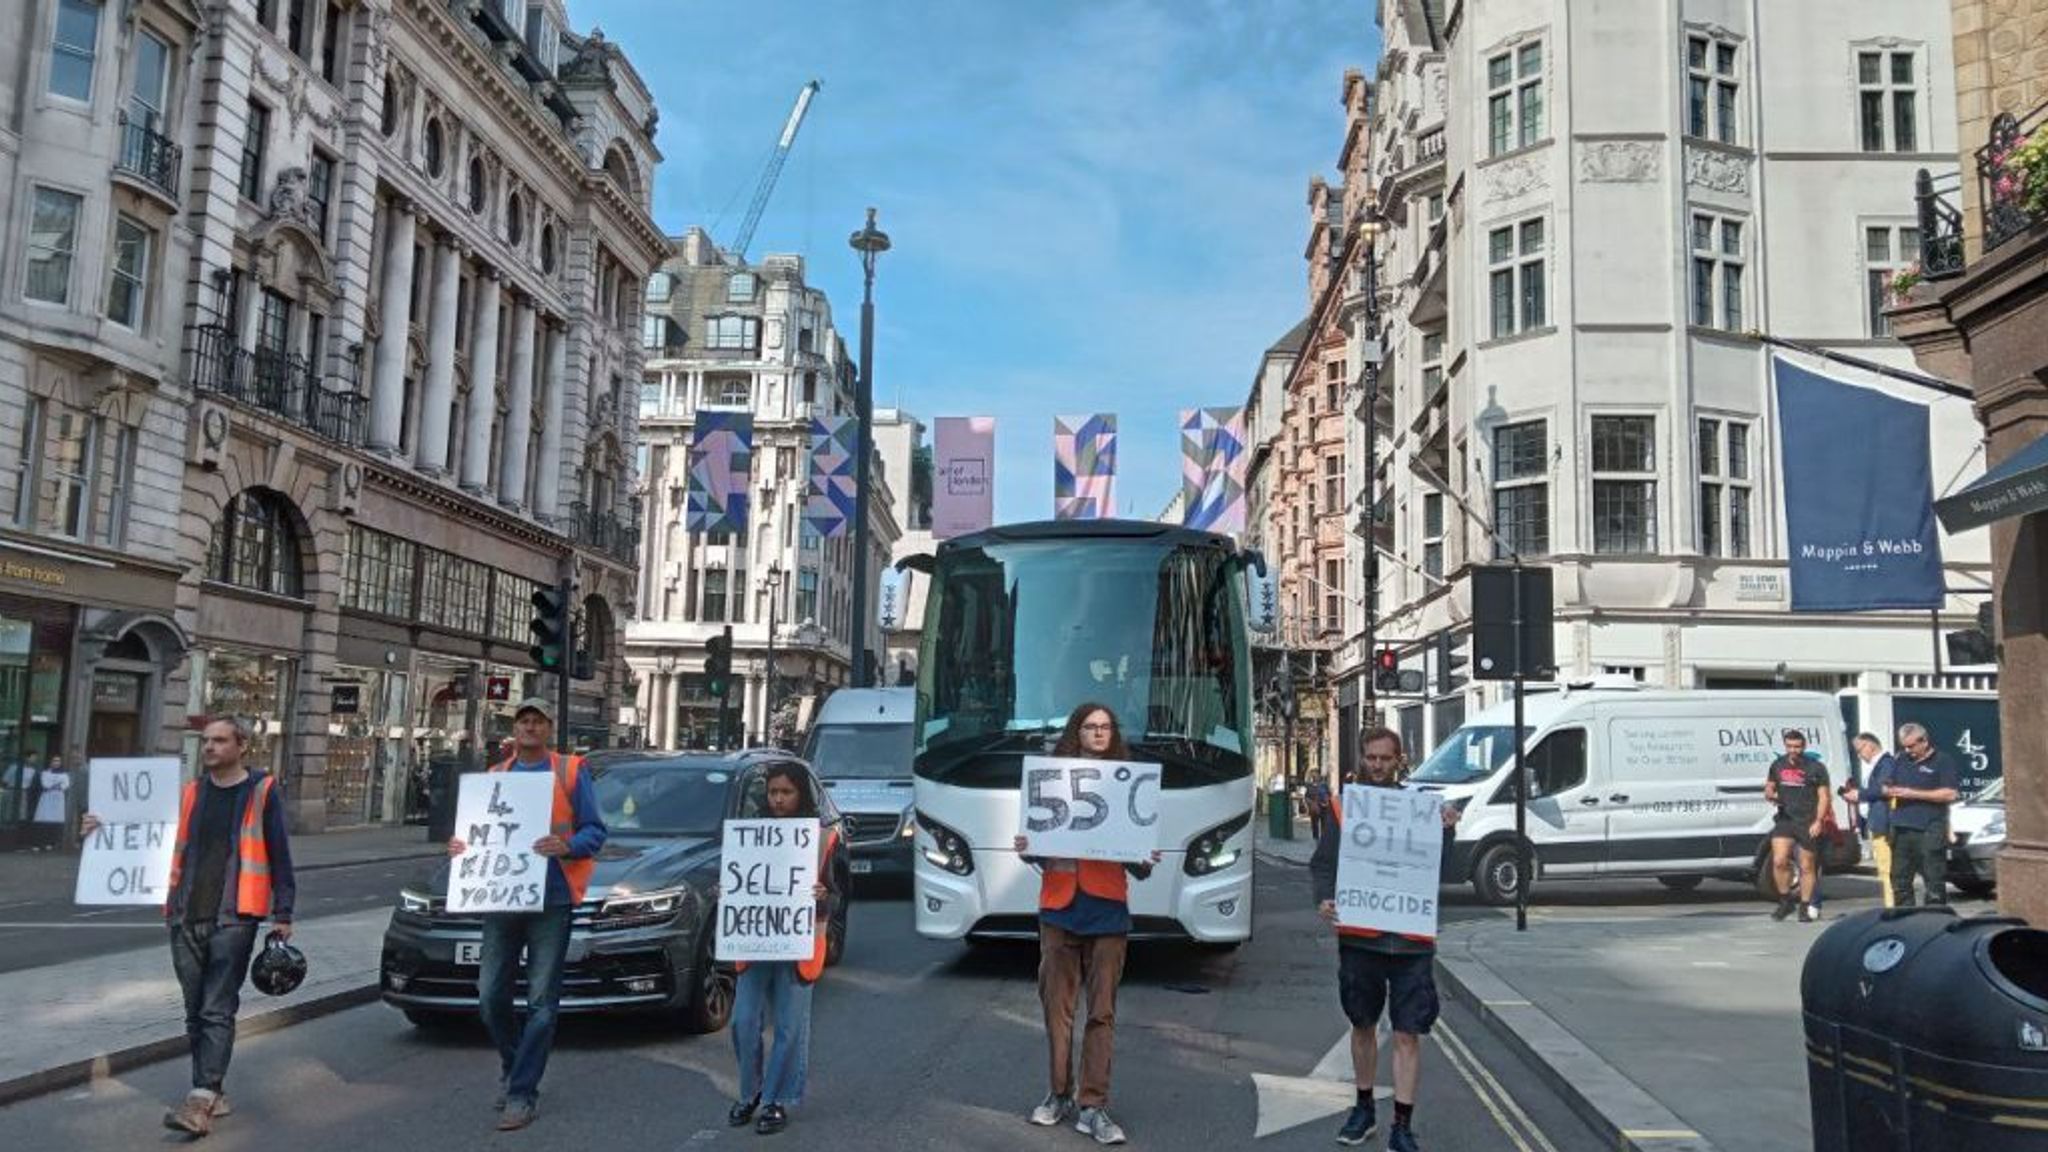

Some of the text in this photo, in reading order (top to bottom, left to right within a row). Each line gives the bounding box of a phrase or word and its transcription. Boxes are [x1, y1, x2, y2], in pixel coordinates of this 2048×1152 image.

[1801, 539, 1923, 562] Mappin & Webb
[1718, 727, 1774, 747] DAILY
[112, 771, 152, 801] NO
[486, 781, 514, 817] 4
[1346, 790, 1437, 823] NEW
[94, 821, 166, 851] NEW
[733, 825, 810, 848] THIS IS
[1352, 822, 1428, 857] OIL
[107, 866, 153, 895] OIL
[727, 861, 806, 896] SELF
[460, 883, 541, 908] YOURS
[1336, 889, 1434, 916] GENOCIDE
[723, 905, 814, 937] DEFENCE!
